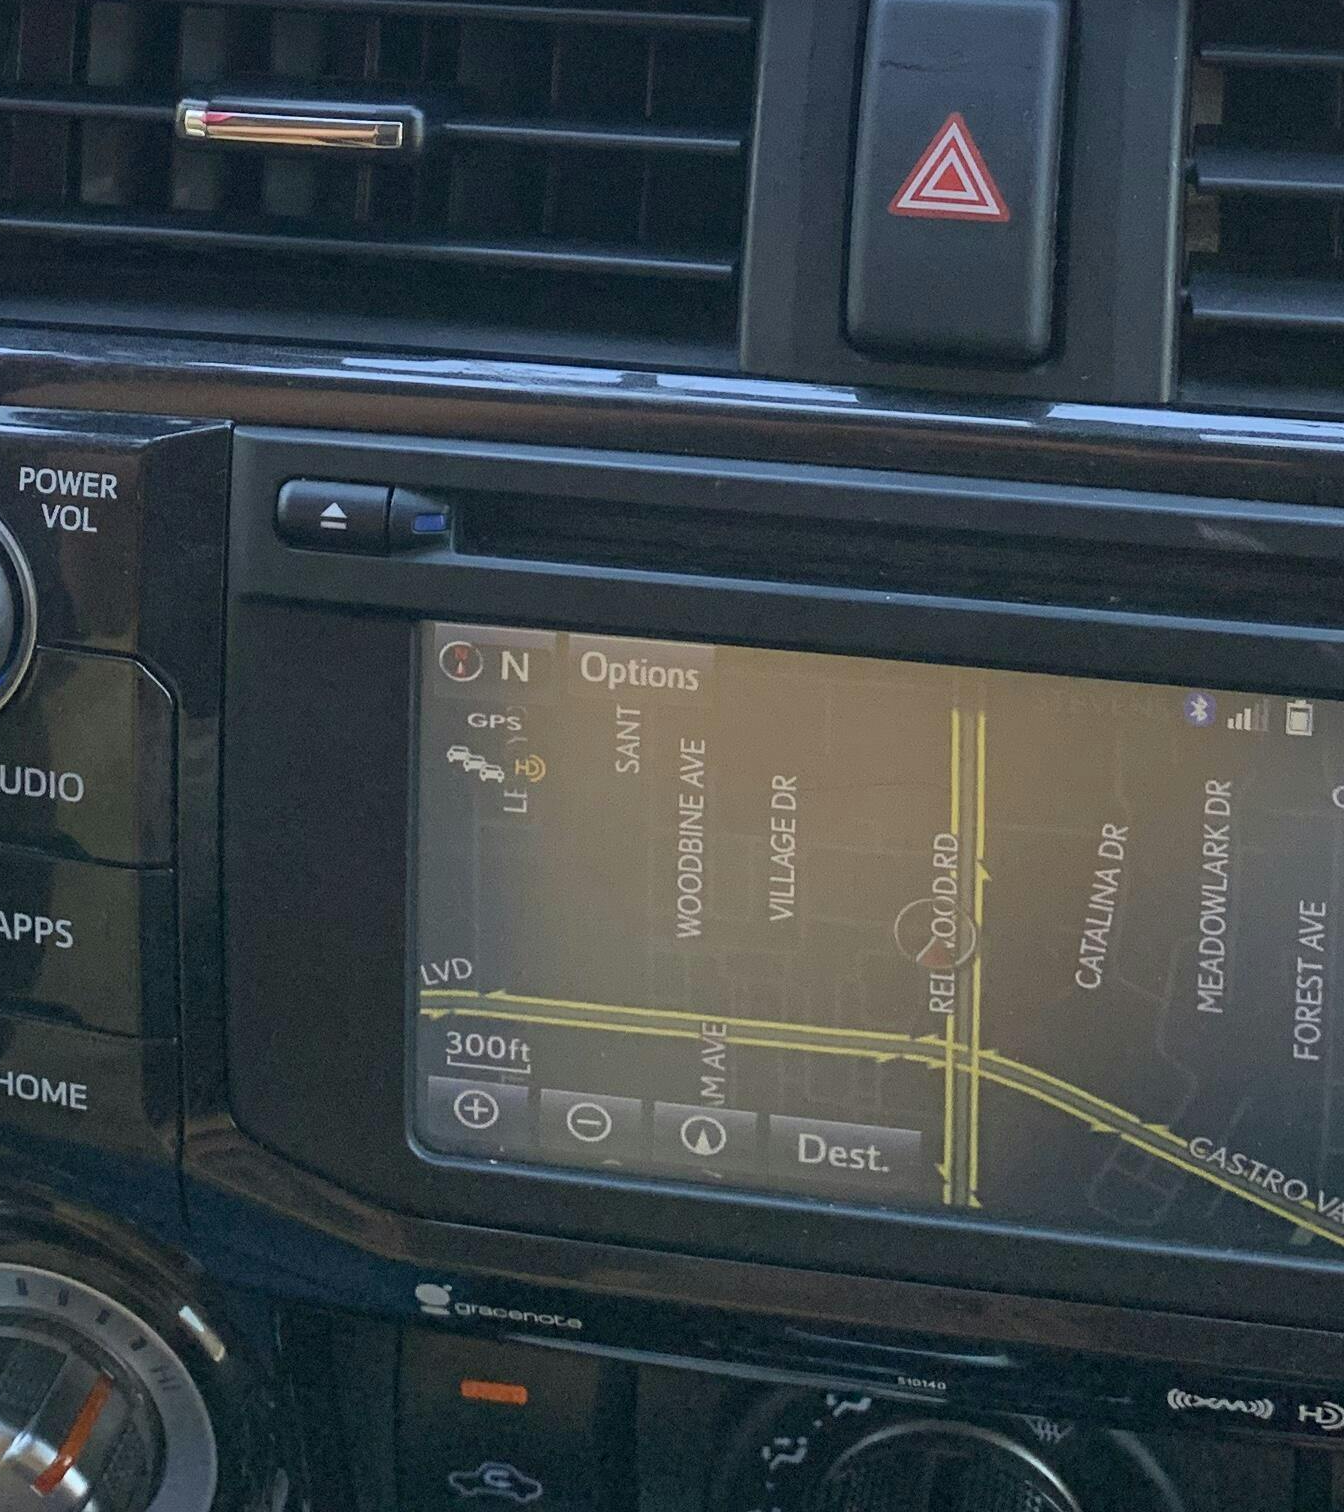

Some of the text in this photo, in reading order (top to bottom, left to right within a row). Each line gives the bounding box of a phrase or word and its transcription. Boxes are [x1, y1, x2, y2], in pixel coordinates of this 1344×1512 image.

[18, 466, 118, 500] POWER
[41, 503, 98, 533] VOL
[500, 650, 530, 683] N
[580, 649, 700, 692] Options
[467, 712, 523, 732] GPS
[615, 704, 642, 775] SANT
[675, 737, 707, 940] WOODBINE AVE
[768, 774, 799, 924] VILLAGE DR
[932, 832, 959, 870] RD
[1074, 822, 1130, 990] CATALINA DR
[1196, 778, 1233, 1014] MEADOWLARK DR
[420, 957, 473, 986] LVD
[1293, 899, 1328, 1061] FOREST AVE
[445, 1030, 532, 1062] 300ft
[701, 1021, 727, 1071] AVE
[798, 1133, 890, 1174] Dest.
[1189, 1137, 1308, 1202] CASTRO
[454, 1301, 583, 1330] gracenote
